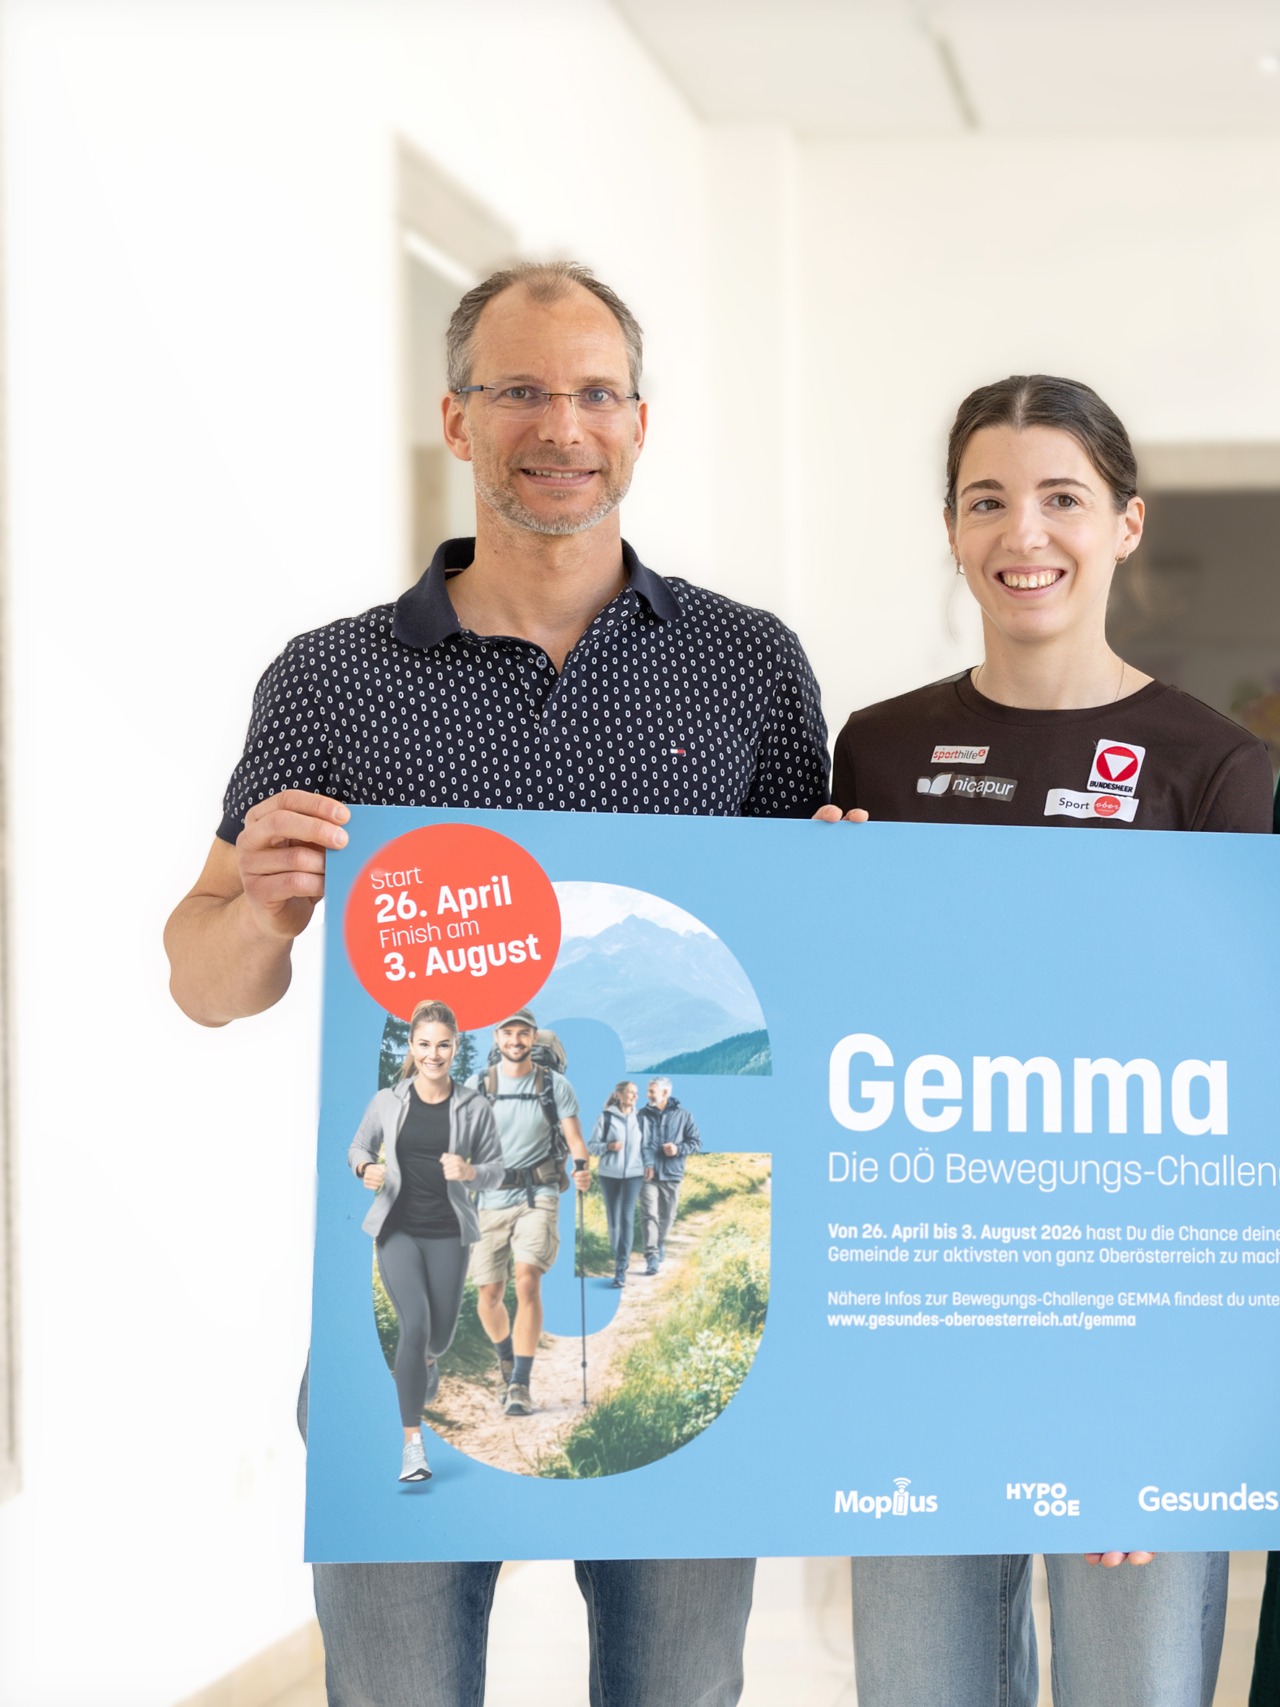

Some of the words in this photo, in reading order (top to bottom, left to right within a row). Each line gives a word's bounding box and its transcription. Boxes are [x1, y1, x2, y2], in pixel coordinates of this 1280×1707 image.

[933, 750, 978, 760] sporthilfe
[952, 778, 1014, 795] nicapur
[1089, 780, 1133, 793] BUNDESHEER
[1058, 797, 1090, 809] Sport
[370, 867, 423, 889] Start
[374, 891, 428, 923] 26.
[437, 875, 512, 919] April
[379, 923, 442, 948] Finish
[446, 920, 480, 939] am
[383, 952, 416, 981] 3.
[425, 933, 541, 977] August
[829, 1033, 1228, 1136] Gemma
[828, 1152, 878, 1182] Die
[889, 1147, 934, 1183] OÖ
[827, 1223, 858, 1239] Von
[861, 1223, 888, 1239] 26.
[891, 1222, 929, 1243] April
[933, 1222, 958, 1240] bis
[961, 1223, 977, 1240] 3.
[980, 1224, 1037, 1243] August
[1040, 1224, 1083, 1241] 2026
[1086, 1224, 1122, 1241] hast
[1126, 1225, 1147, 1241] Du
[1150, 1224, 1175, 1241] die
[1178, 1224, 1239, 1242] Chance
[828, 1245, 910, 1263] Gemeinde
[913, 1249, 939, 1263] zur
[943, 1246, 1019, 1263] aktivsten
[1022, 1249, 1052, 1263] von
[1055, 1250, 1095, 1267] ganz
[1098, 1247, 1216, 1264] Oberösterreich
[1219, 1251, 1238, 1264] zu
[827, 1290, 882, 1306] Nähere
[884, 1290, 922, 1306] Infos
[925, 1293, 949, 1306] zur
[952, 1291, 1115, 1309] Bewegungs-Challenge
[1117, 1291, 1171, 1307] GEMMA
[1173, 1291, 1224, 1307] findest
[1226, 1291, 1245, 1307] du
[827, 1311, 1137, 1331] www.gesundes-oberoesterreich.at/gemma
[1006, 1482, 1067, 1500] HYPO
[1138, 1482, 1279, 1512] Gesundes
[1033, 1498, 1081, 1517] OOE
